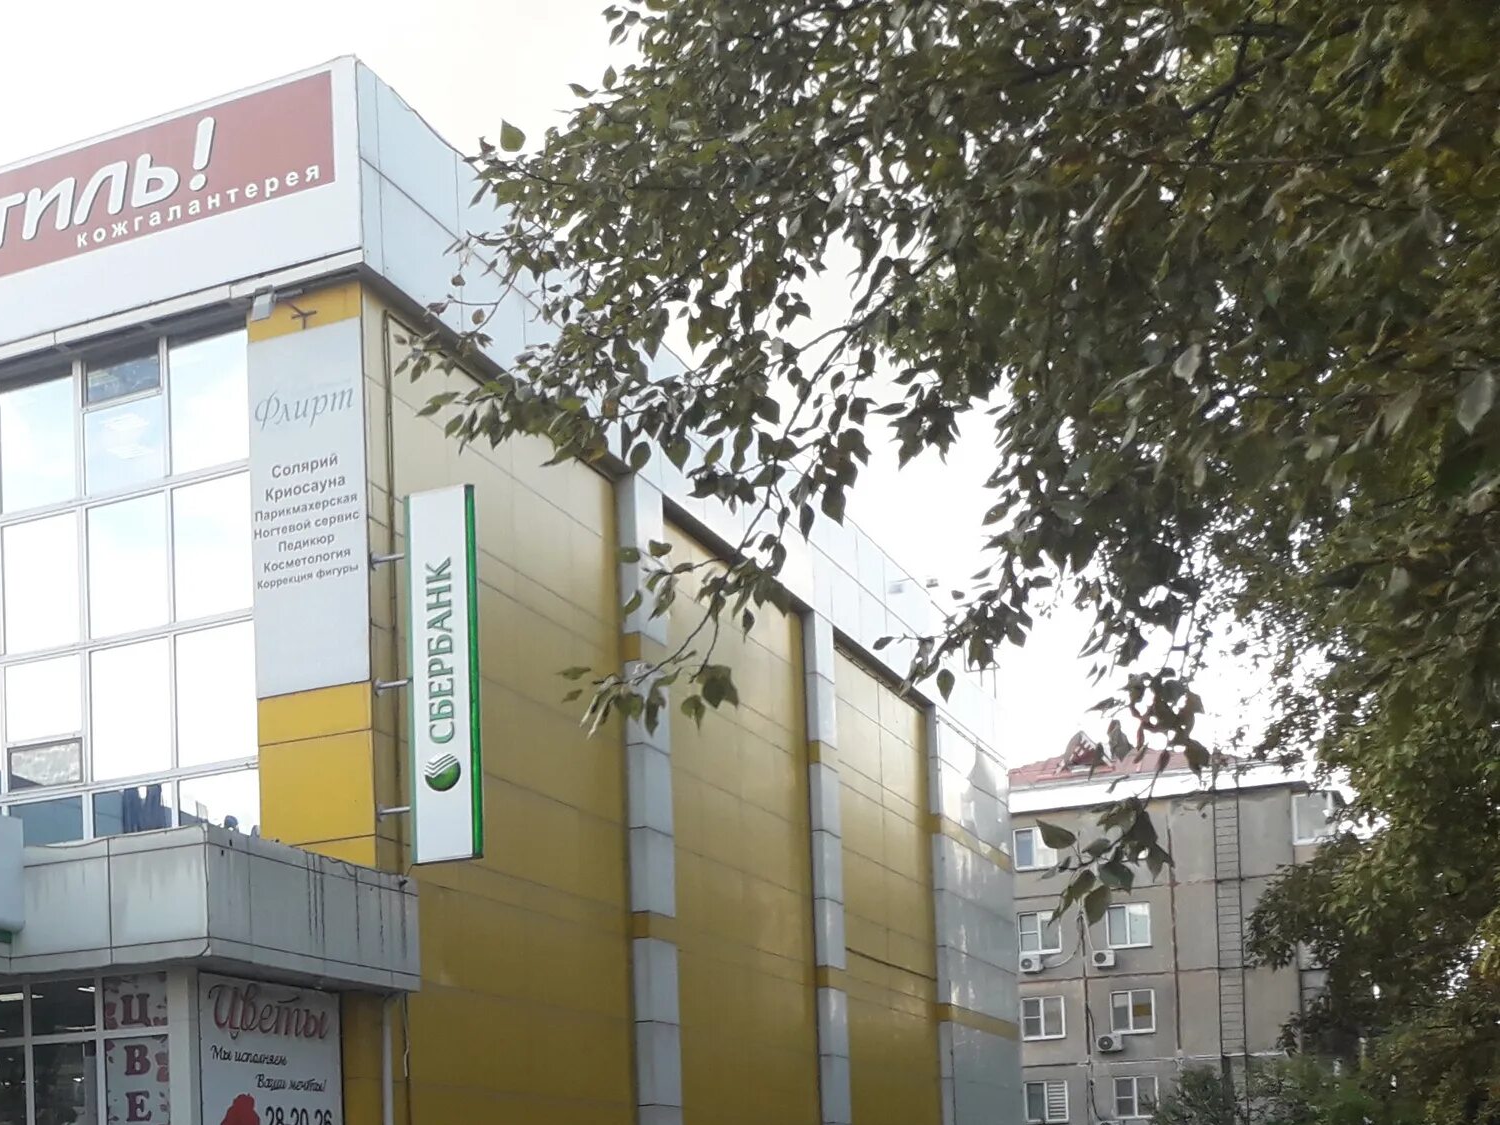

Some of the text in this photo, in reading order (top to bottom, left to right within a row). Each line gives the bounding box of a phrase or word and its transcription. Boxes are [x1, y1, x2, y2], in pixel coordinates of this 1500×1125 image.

[76, 164, 324, 250] кожгалантерея
[254, 384, 356, 432] Флирт
[271, 452, 339, 480] Солярий
[264, 475, 347, 503] Криосауна
[254, 492, 359, 523] Парикмахерская
[253, 510, 361, 541] Ногтевой сервис
[277, 532, 336, 554] Педикюр
[263, 547, 352, 574] Косметология
[256, 564, 360, 591] Коррекция фигуры
[424, 556, 455, 745] СБЕРБАНК
[208, 982, 330, 1042] Цветы
[210, 1045, 288, 1067] Мы исполняем
[255, 1073, 328, 1093] Ваши мечты!
